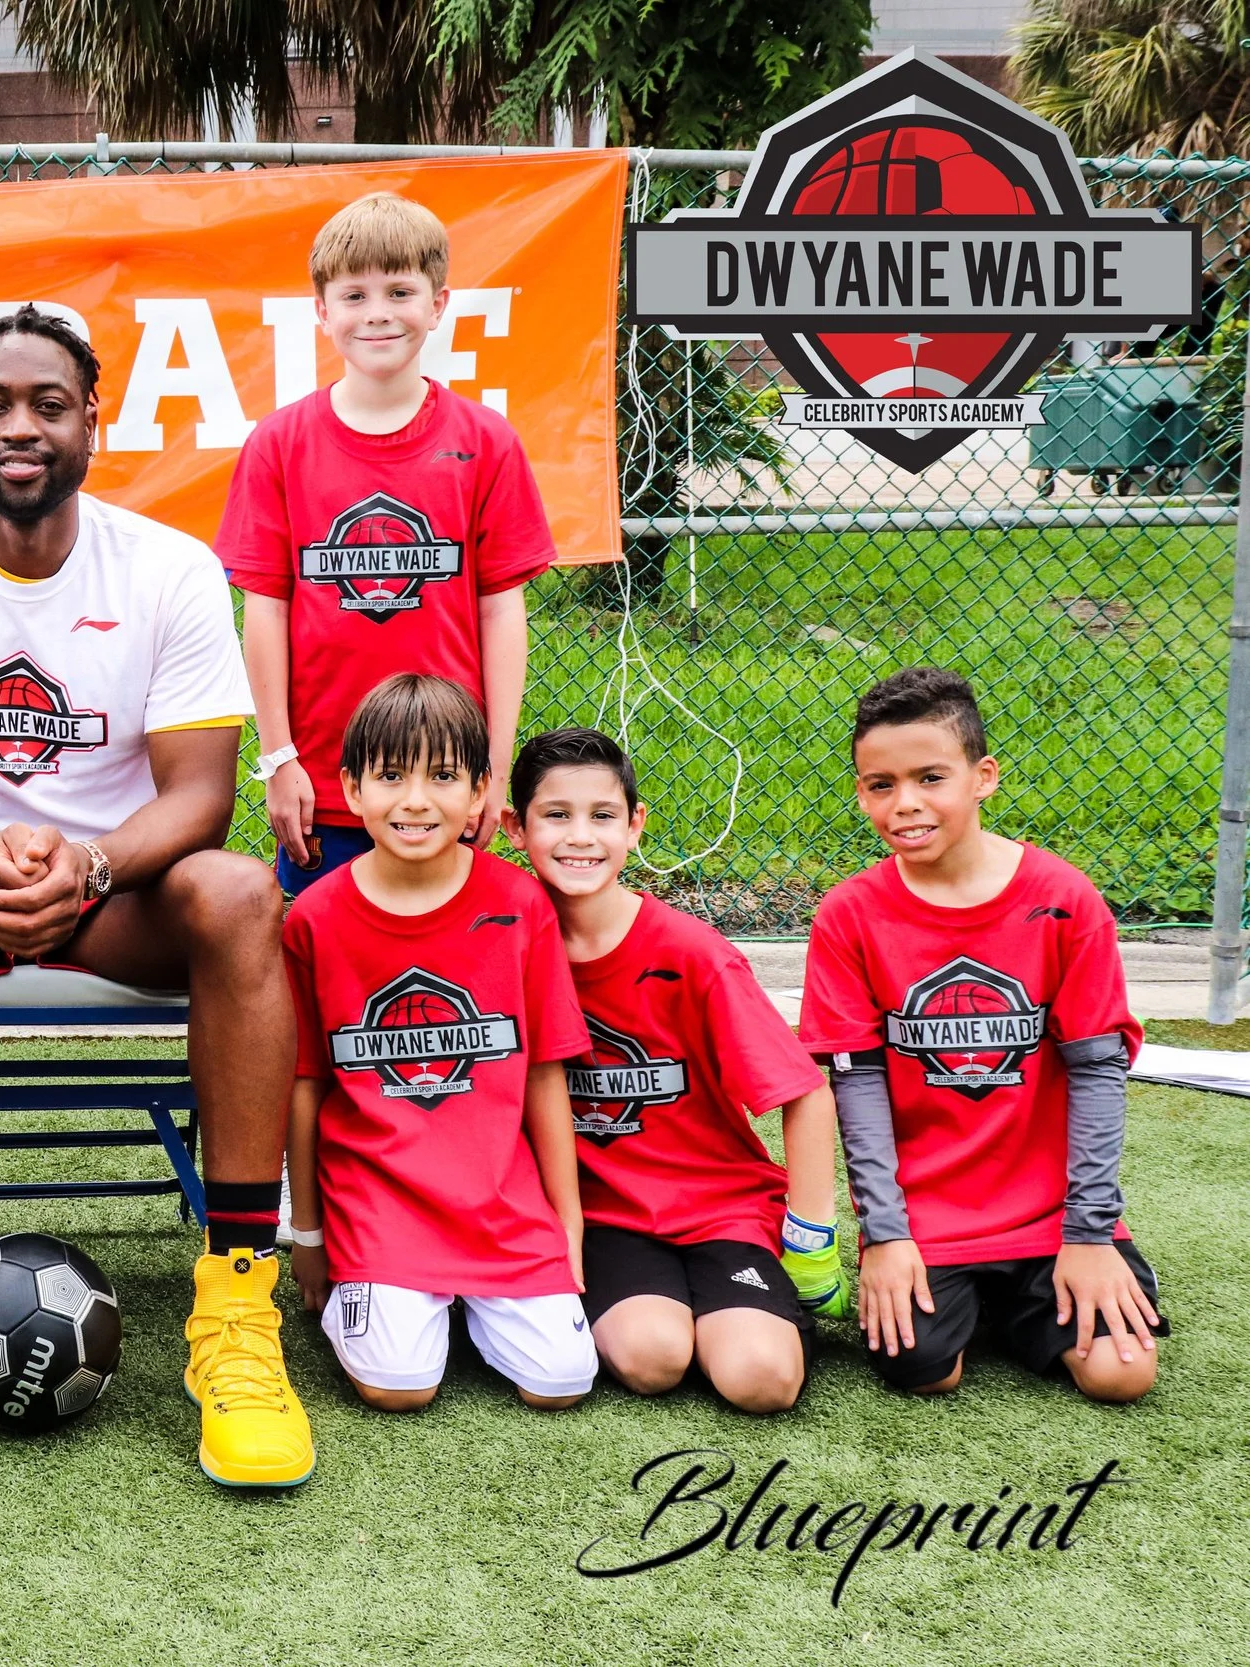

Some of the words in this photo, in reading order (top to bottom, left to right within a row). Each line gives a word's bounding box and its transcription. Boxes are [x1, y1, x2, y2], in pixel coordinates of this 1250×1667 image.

[319, 550, 391, 573] DWYANE
[395, 548, 441, 570] WADE
[32, 715, 81, 740] WADE
[354, 1030, 435, 1058] DWYANE
[437, 1025, 493, 1051] WADE
[899, 1020, 981, 1045] DWYANE
[985, 1016, 1039, 1043] WADE
[567, 1070, 604, 1095] ANE
[607, 1069, 662, 1094] WADE
[730, 1274, 770, 1291] adidas
[3, 1336, 55, 1418] mitre
